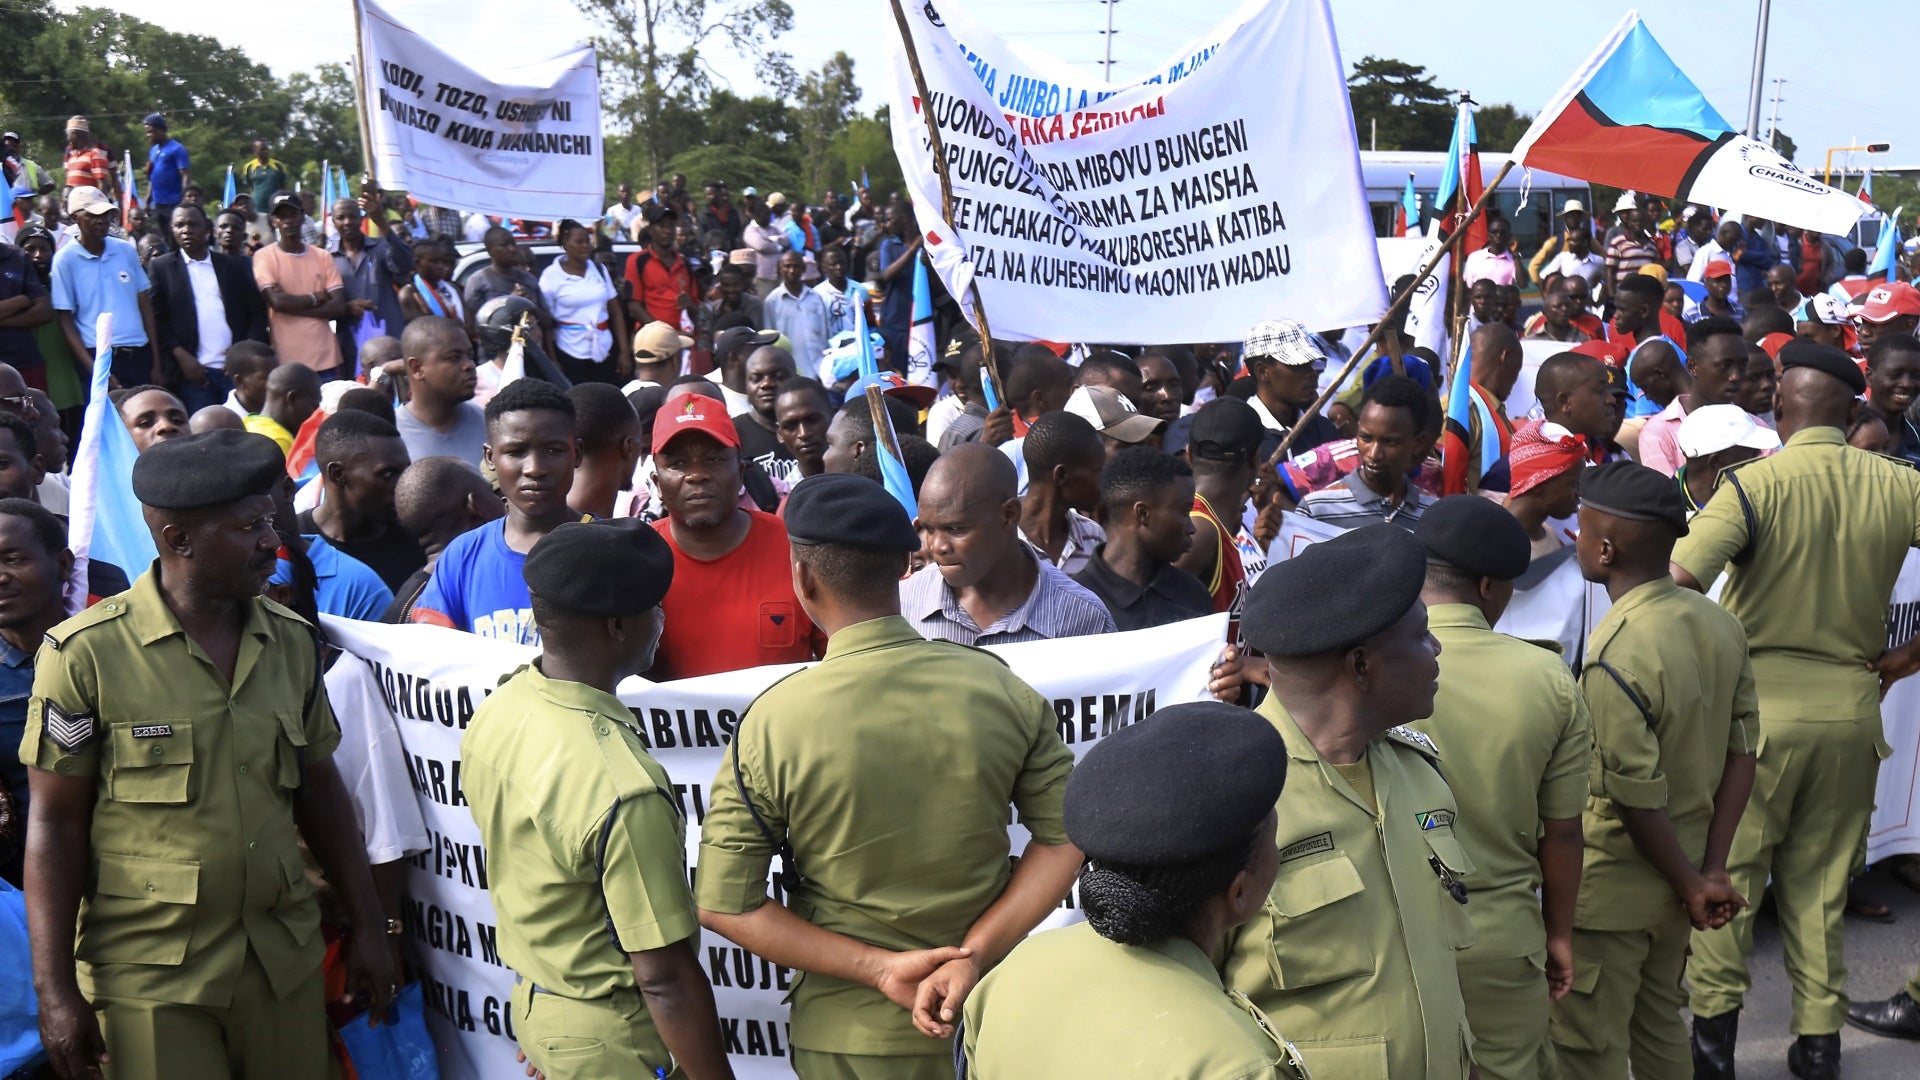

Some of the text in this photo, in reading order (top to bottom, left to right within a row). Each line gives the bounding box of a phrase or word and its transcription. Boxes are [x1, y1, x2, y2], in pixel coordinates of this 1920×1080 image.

[380, 58, 424, 99] KODI,
[434, 82, 489, 120] TOZO,
[551, 101, 571, 122] NI
[1000, 73, 1060, 119] JIMBO
[443, 121, 495, 150] KWA
[496, 132, 592, 156] WANANCHI
[1076, 142, 1151, 190] MIBOVU
[1155, 118, 1249, 172] BUNGENI
[1135, 185, 1169, 221] ZA
[1170, 162, 1259, 213] MAISHA
[1755, 167, 1825, 193] CHADEMA
[973, 200, 1077, 248] MCHAKATO
[1216, 200, 1287, 247] KATIBA
[1001, 250, 1026, 284] NA
[1030, 255, 1132, 295] KUHESHIMU
[1220, 243, 1292, 288] WADAU
